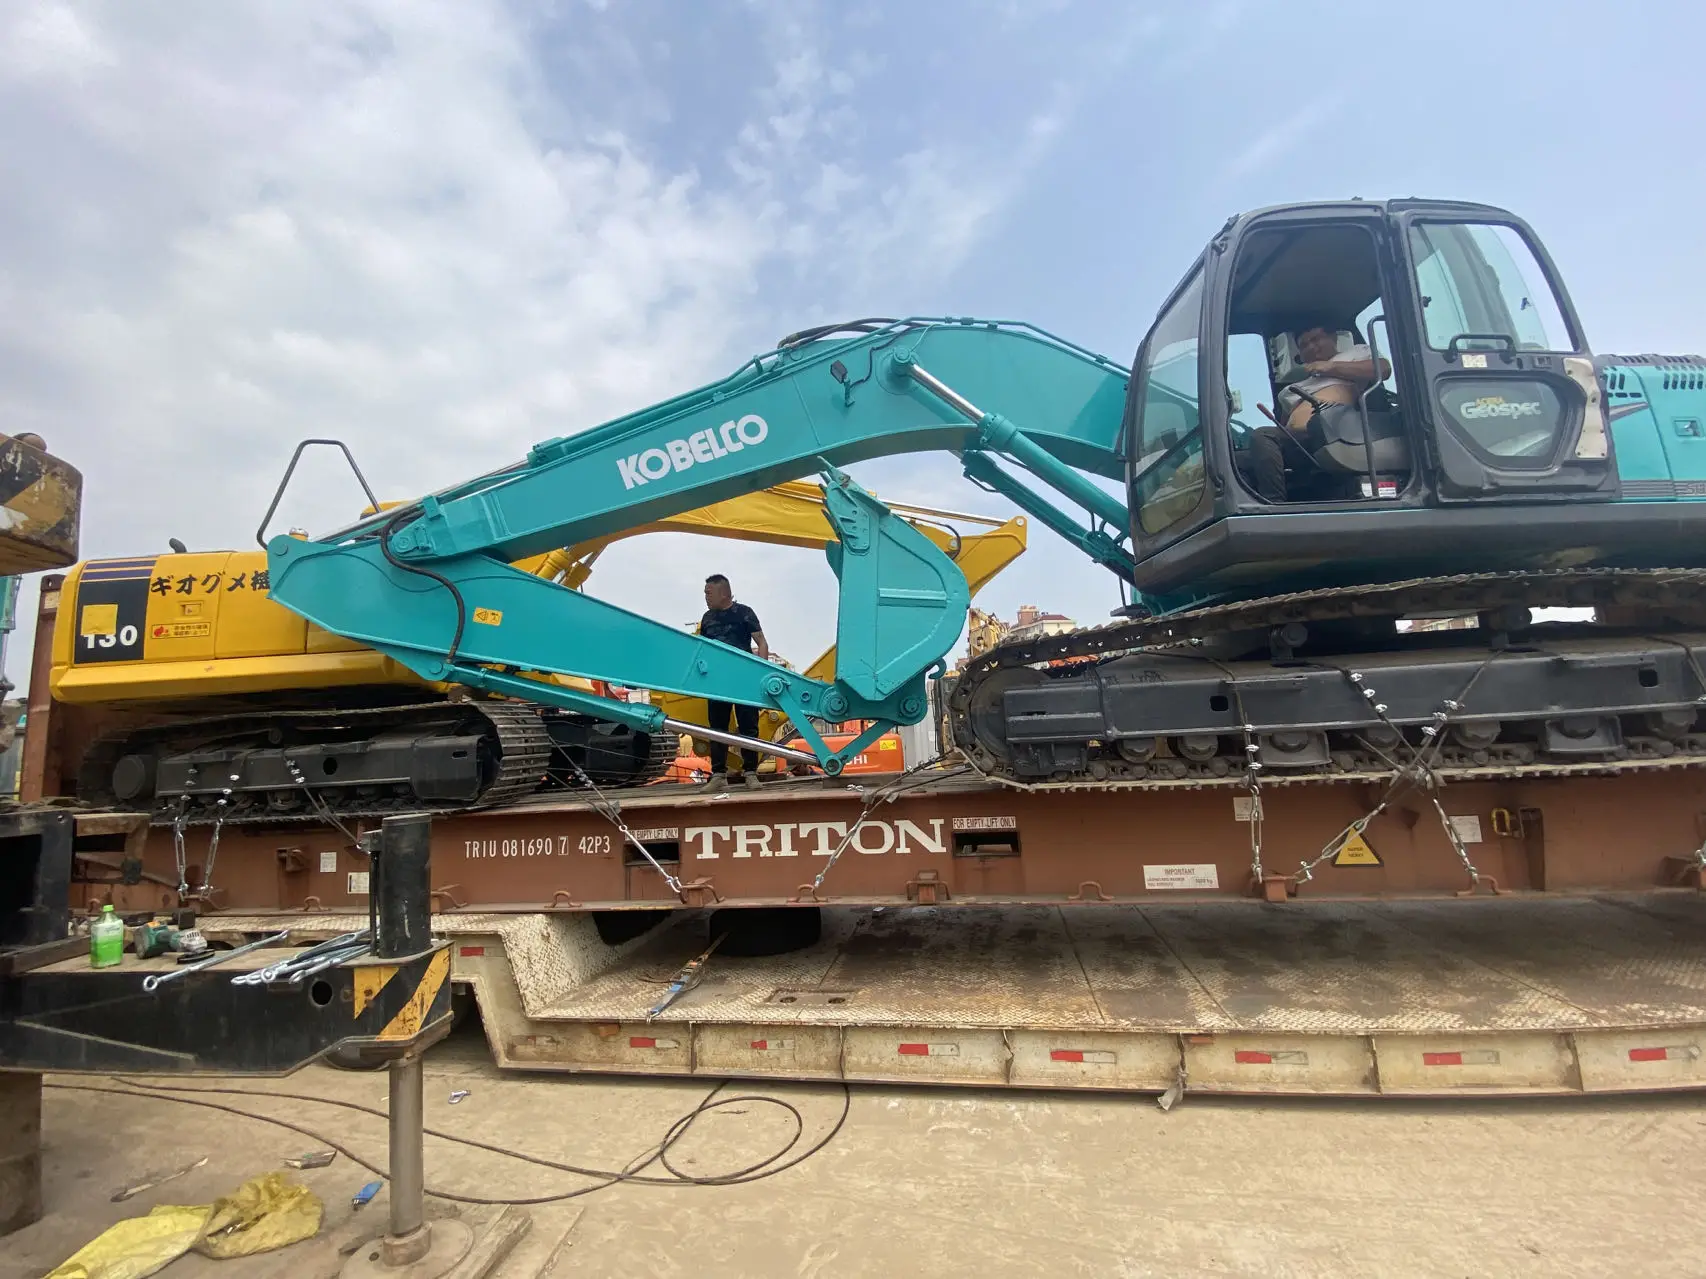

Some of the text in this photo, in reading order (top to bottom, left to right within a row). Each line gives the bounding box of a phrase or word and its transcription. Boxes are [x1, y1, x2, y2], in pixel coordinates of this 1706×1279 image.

[616, 414, 768, 490] KOBELCO
[953, 819, 965, 829] FOR
[966, 818, 984, 828] EMPTY
[1000, 816, 1015, 828] ONLY
[465, 836, 610, 858] TRIU 081690 7 42P3
[684, 818, 947, 859] TRITON
[1164, 868, 1195, 876] IMPORTANT
